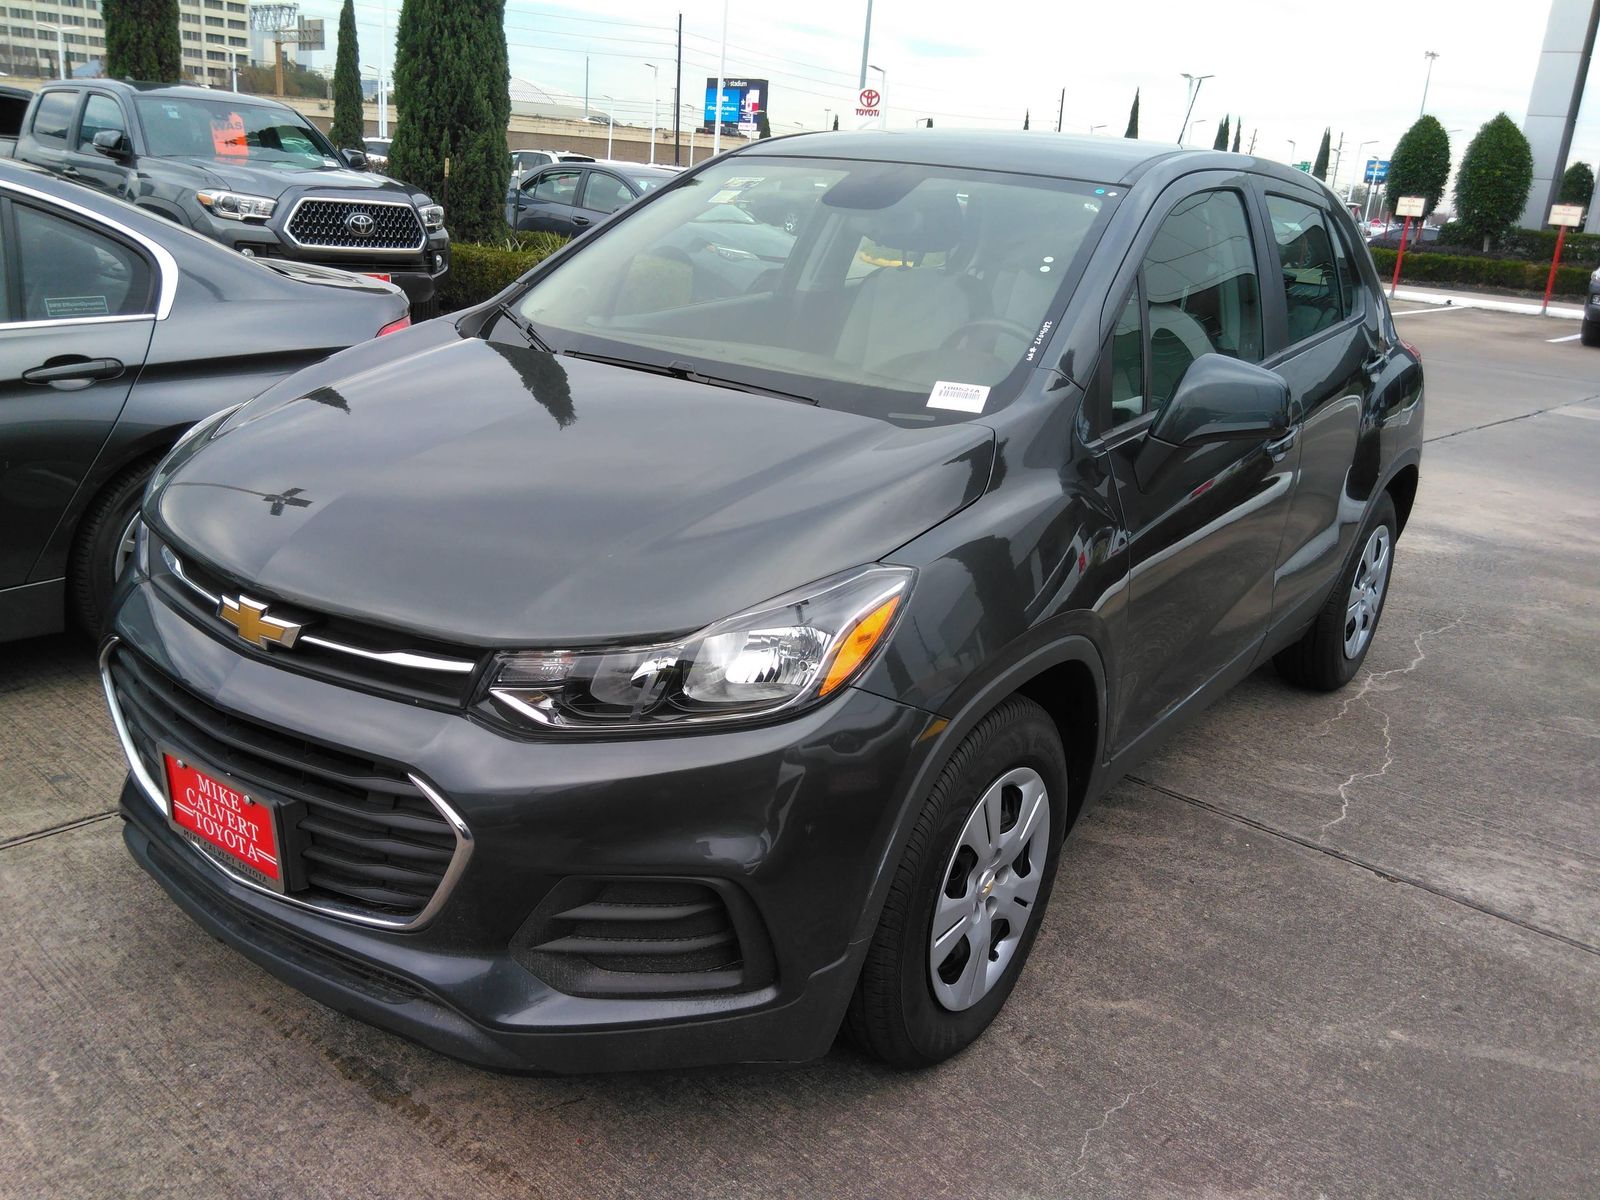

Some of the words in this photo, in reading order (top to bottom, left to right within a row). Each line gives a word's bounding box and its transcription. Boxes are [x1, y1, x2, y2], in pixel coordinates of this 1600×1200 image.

[186, 787, 259, 842] CALVERT
[196, 773, 242, 813] MIKE
[183, 829, 202, 846] MIKE
[203, 841, 236, 866] CALVERT
[238, 862, 269, 884] TOYOTA
[193, 809, 260, 863] TOYOTA
